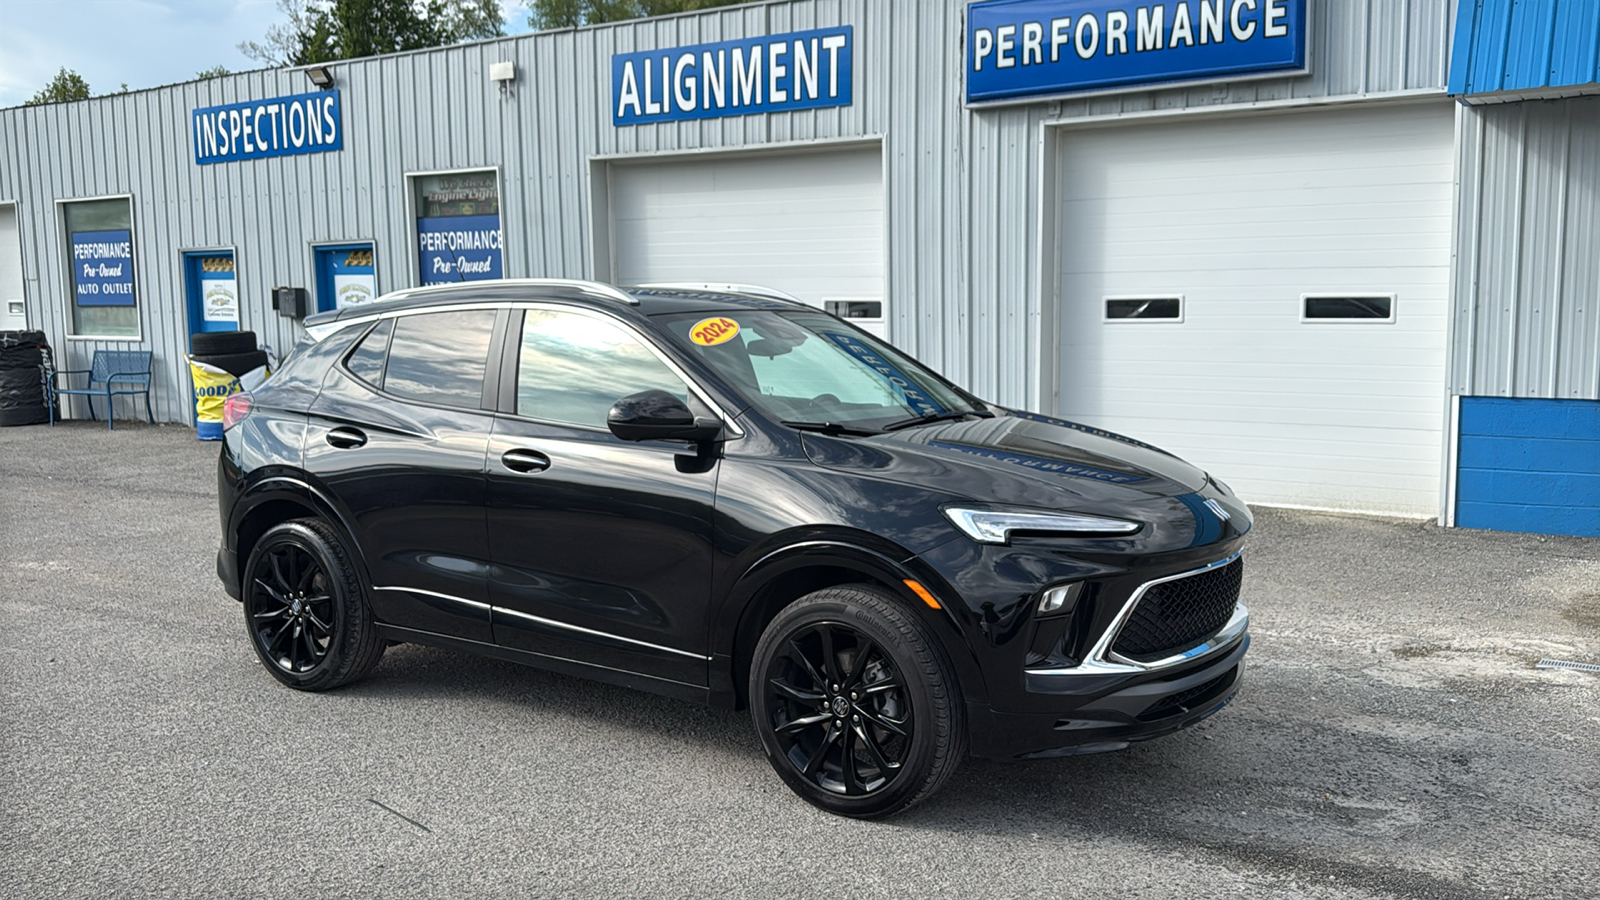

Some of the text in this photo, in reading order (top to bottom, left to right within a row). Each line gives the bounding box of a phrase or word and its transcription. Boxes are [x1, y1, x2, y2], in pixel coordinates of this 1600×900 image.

[973, 0, 1289, 72] PERFORMANCE
[617, 34, 846, 118] ALIGNMENT
[196, 96, 336, 159] INSPECTIONS
[428, 189, 467, 203] Engine
[74, 242, 131, 259] PERFORMANCE
[420, 229, 503, 251] PERFORMANCE
[83, 262, 122, 278] Pre-Owned
[433, 255, 492, 274] Pre-Owned
[77, 282, 133, 295] AUTO OUTLET
[695, 318, 736, 344] 2024
[855, 610, 898, 642] Continental
